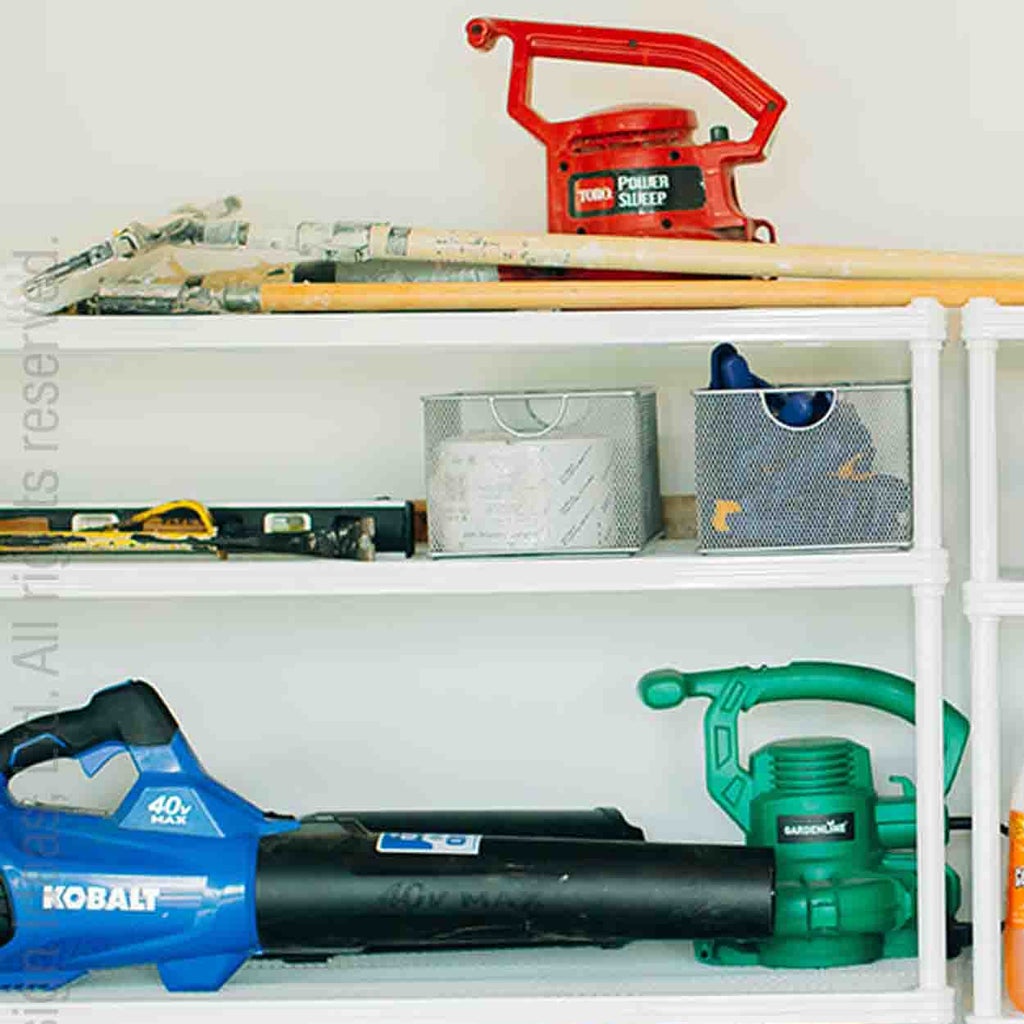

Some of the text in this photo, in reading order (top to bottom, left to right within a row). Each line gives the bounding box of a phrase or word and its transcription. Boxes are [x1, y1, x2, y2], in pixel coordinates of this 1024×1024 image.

[617, 174, 669, 191] POWER
[618, 191, 667, 207] SWEEP
[42, 886, 160, 911] KOBALT
